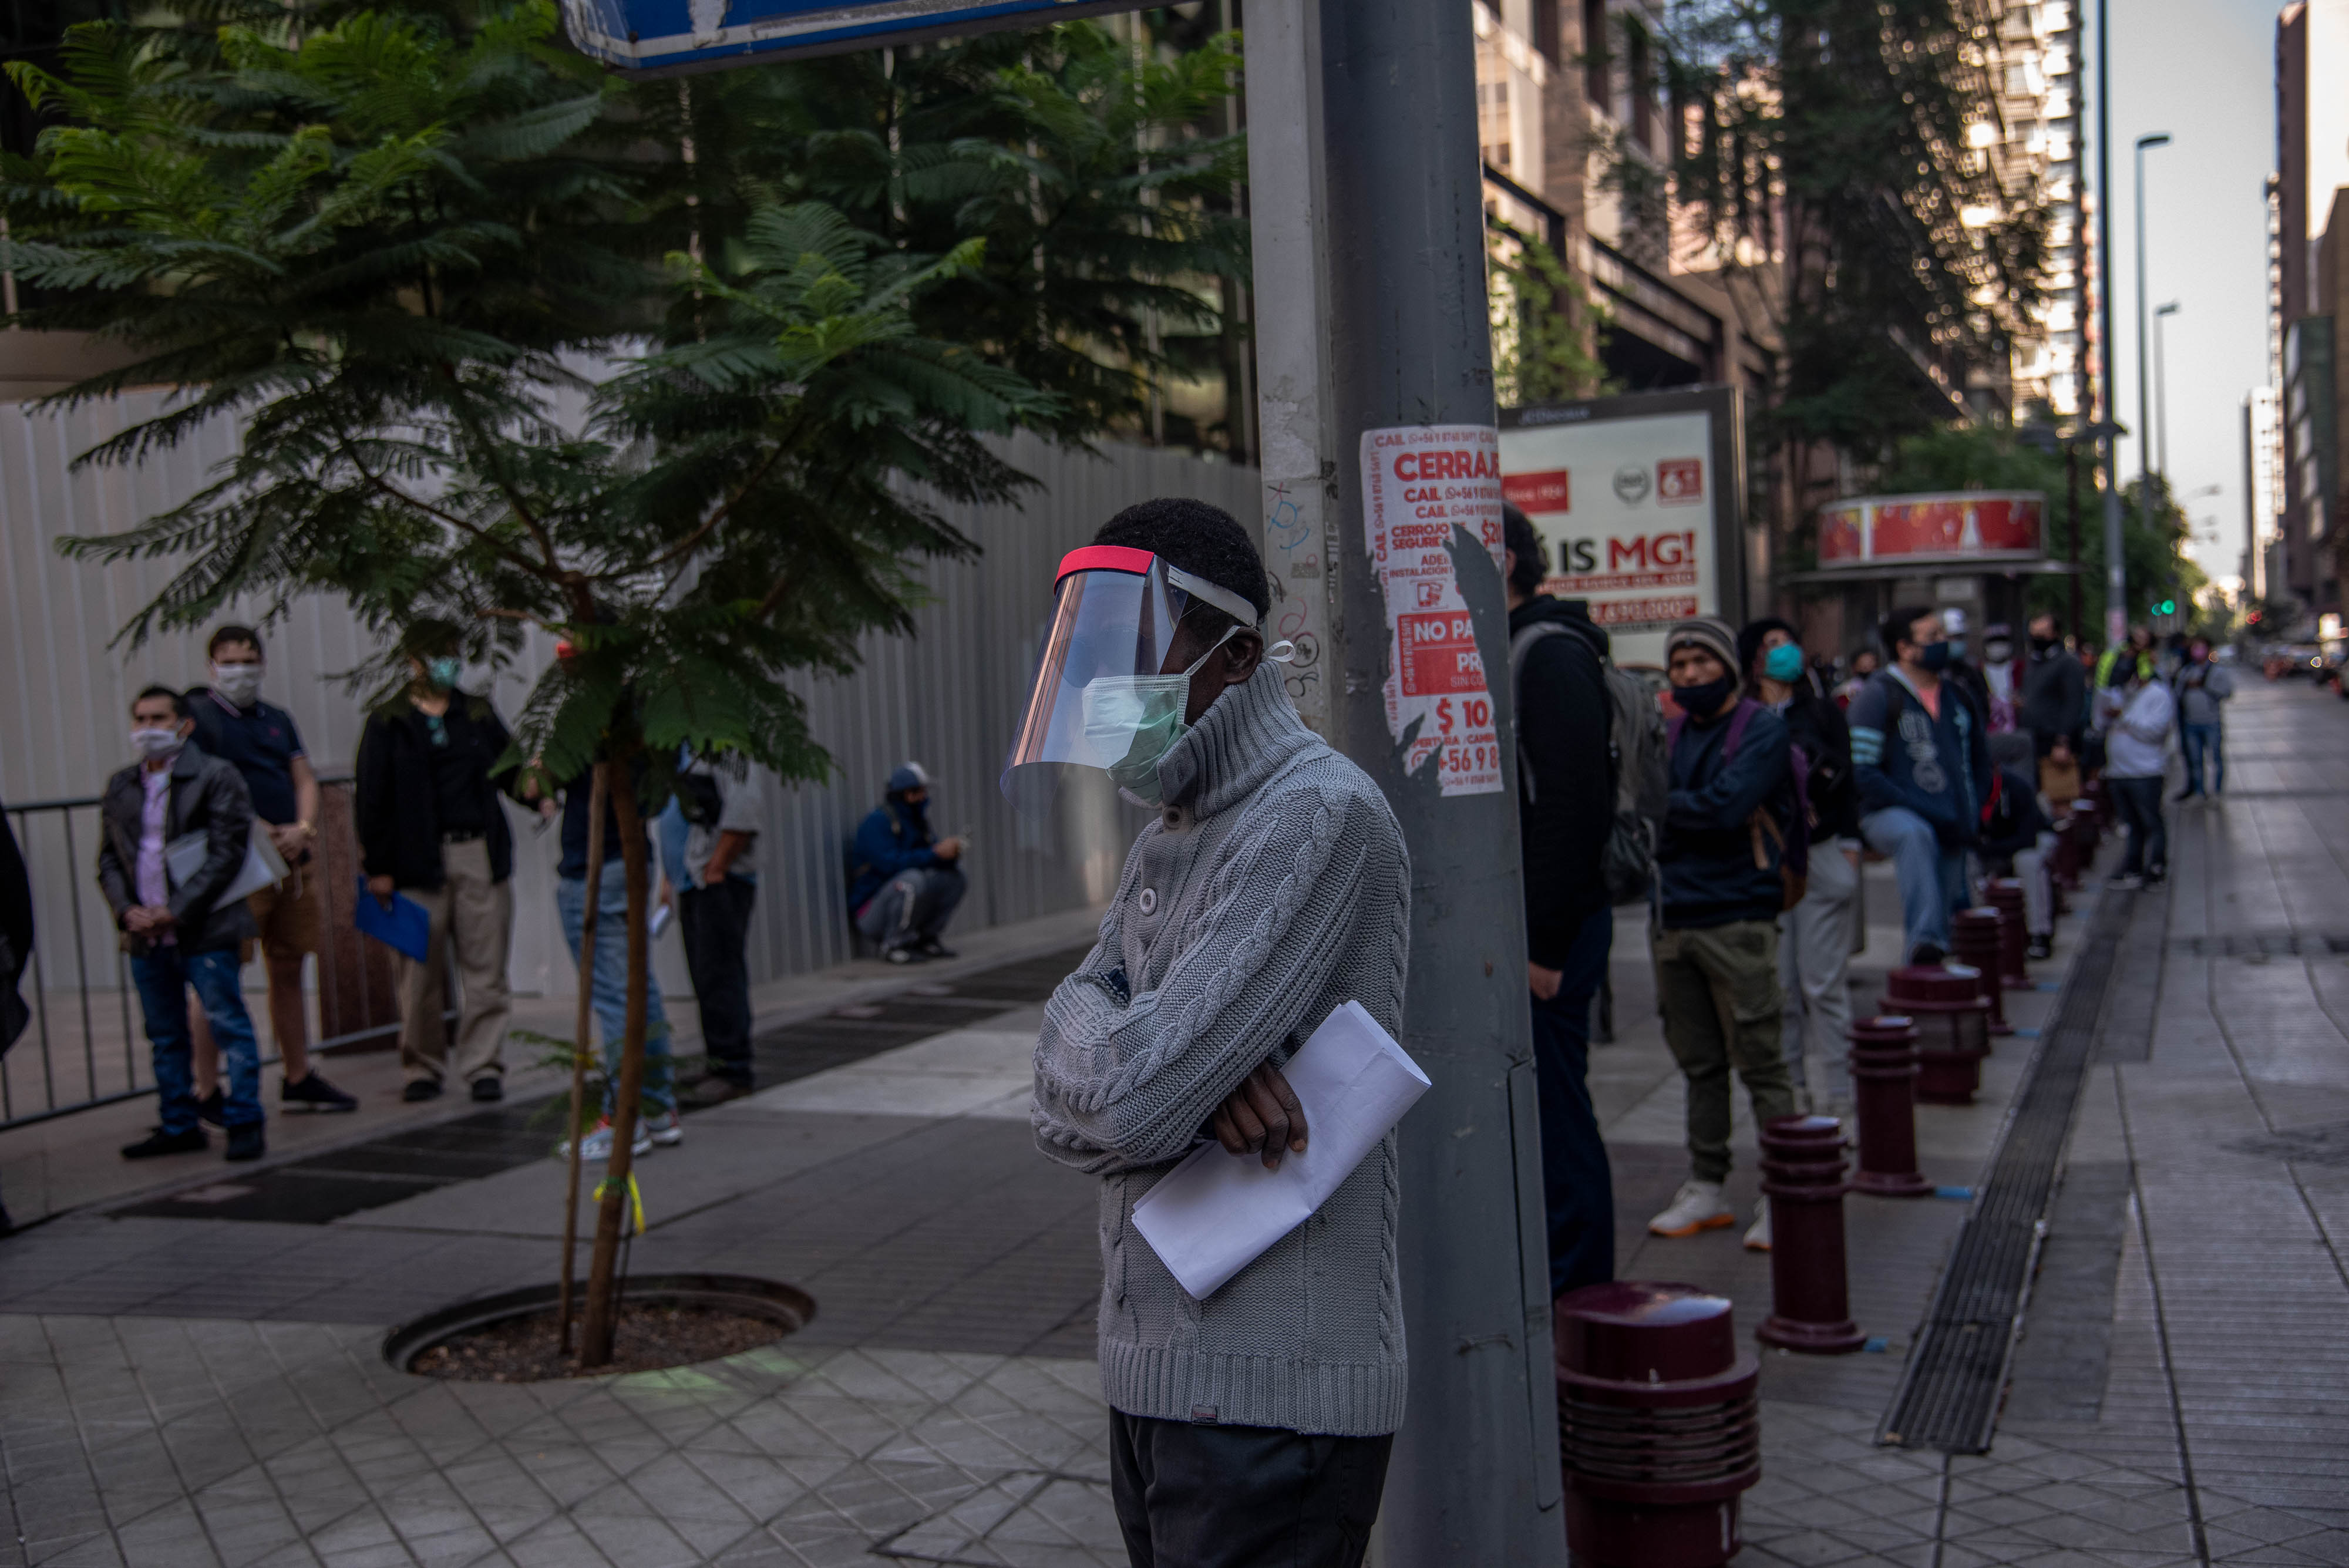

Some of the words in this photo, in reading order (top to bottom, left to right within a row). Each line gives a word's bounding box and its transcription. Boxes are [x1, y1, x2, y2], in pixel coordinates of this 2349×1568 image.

[1391, 522, 1450, 537] CERROJO
[1559, 539, 1596, 574] IS
[1607, 530, 1696, 568] MG!
[1414, 621, 1446, 642] NO
[1436, 697, 1455, 735] $
[1476, 746, 1486, 770] 9
